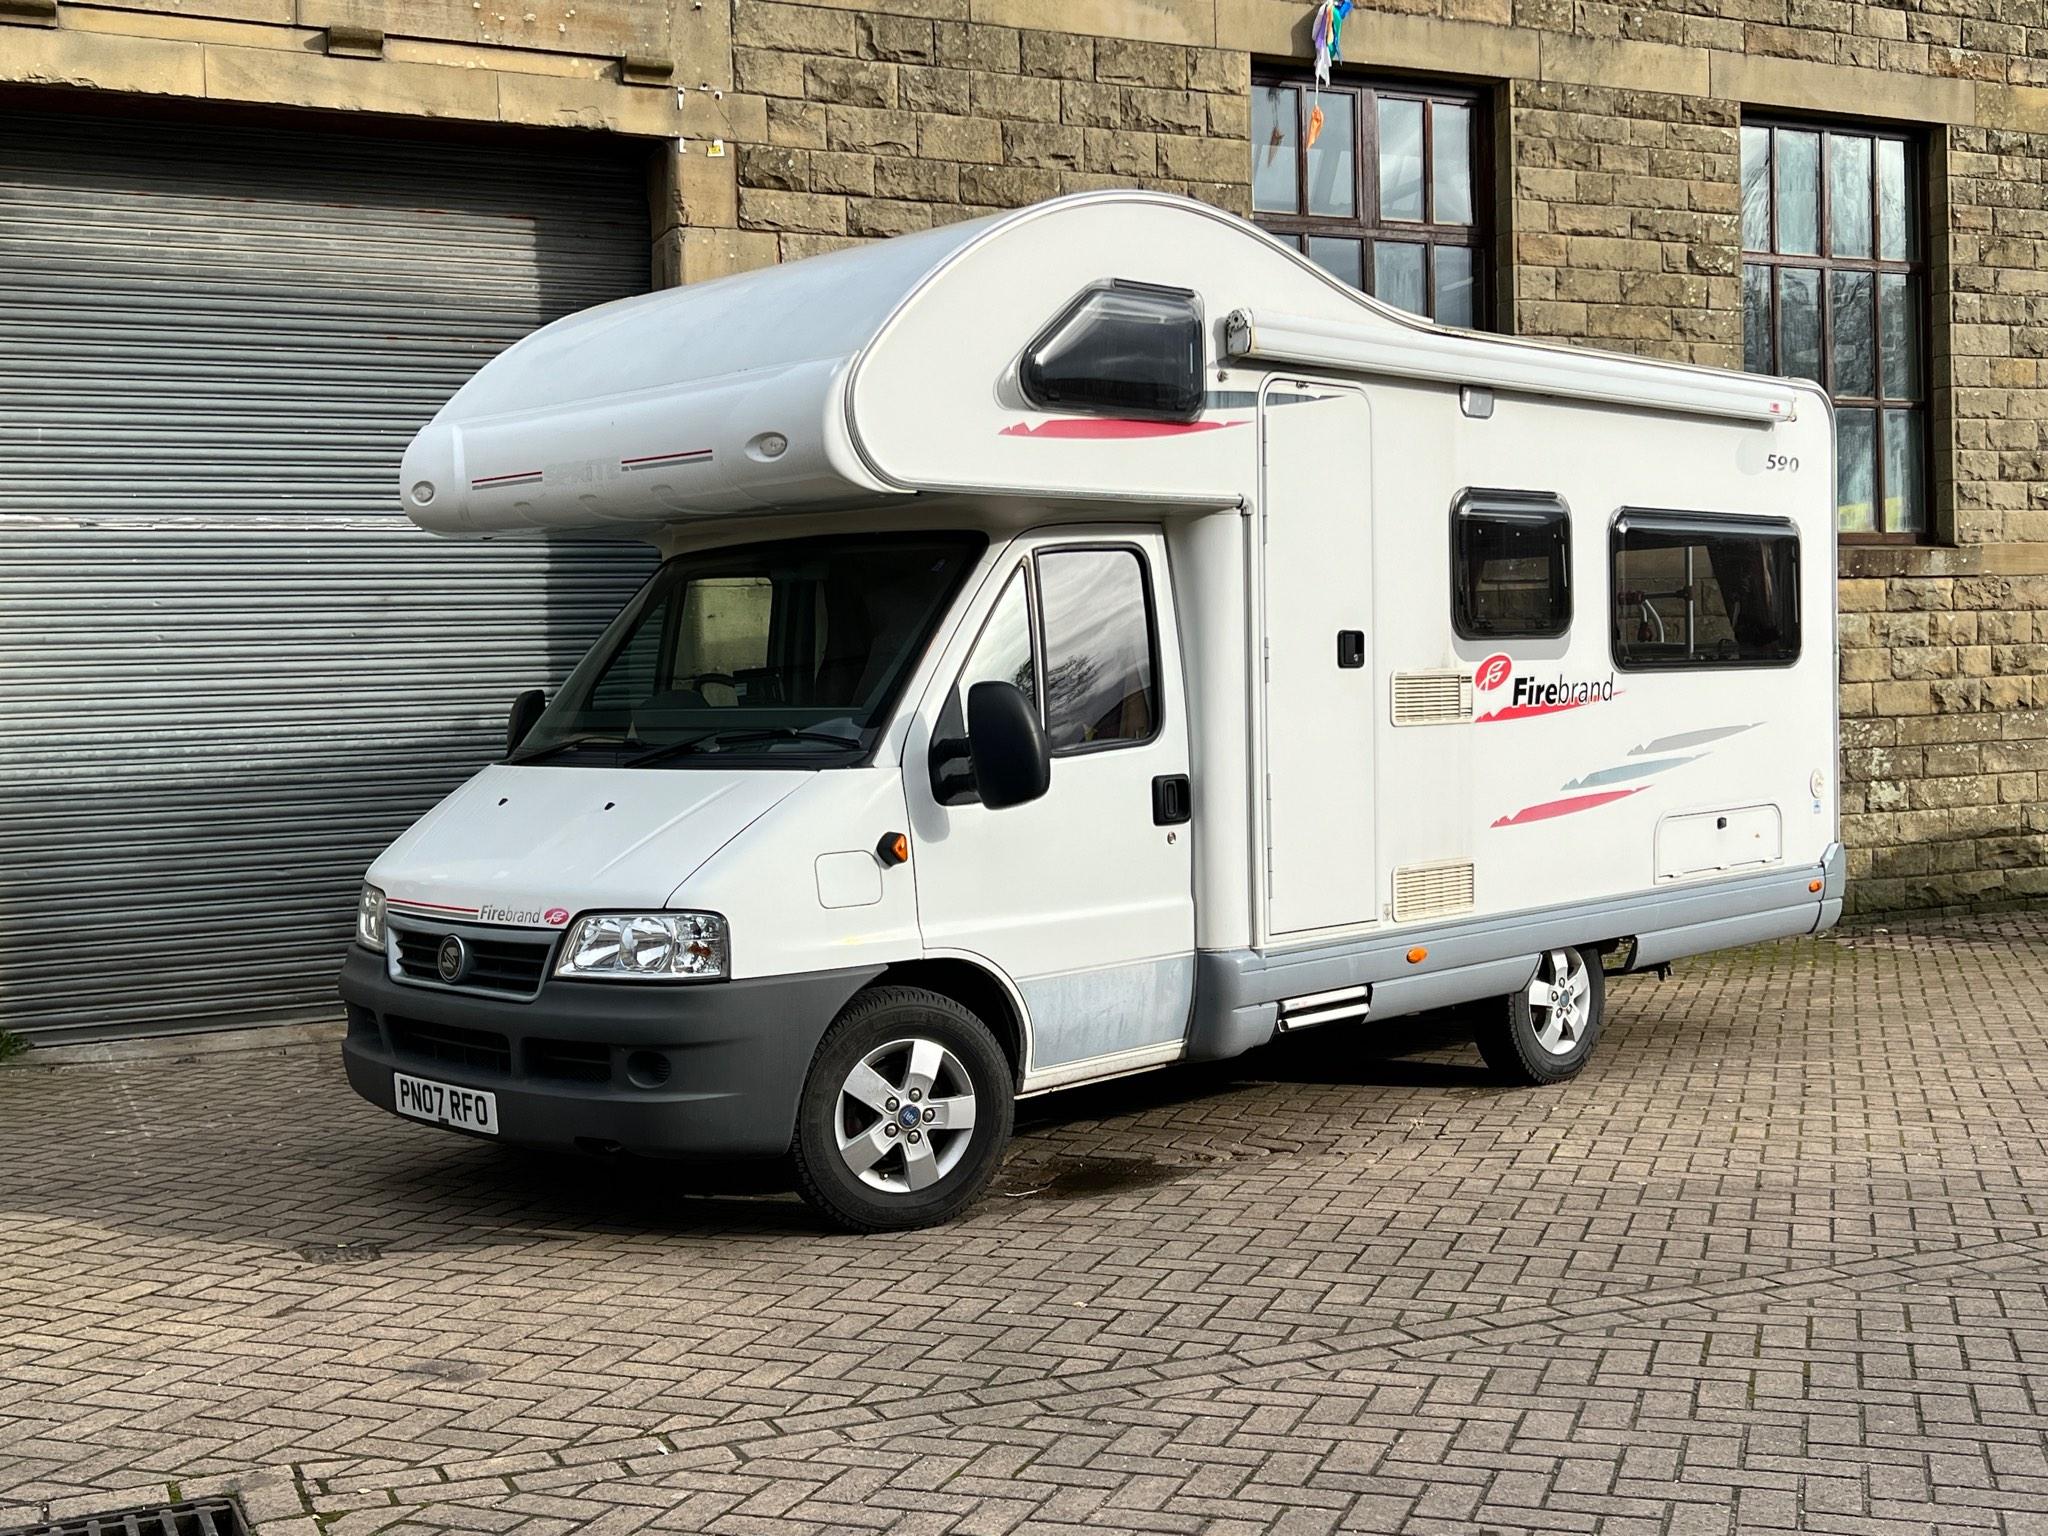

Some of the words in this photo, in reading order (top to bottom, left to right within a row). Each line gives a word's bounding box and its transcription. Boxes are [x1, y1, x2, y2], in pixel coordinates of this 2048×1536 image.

[1766, 454, 1799, 473] 590
[1512, 672, 1614, 706] Firebrand
[480, 904, 541, 923] Firebrand
[399, 1078, 444, 1116] PN07
[449, 1090, 488, 1126] RFO
